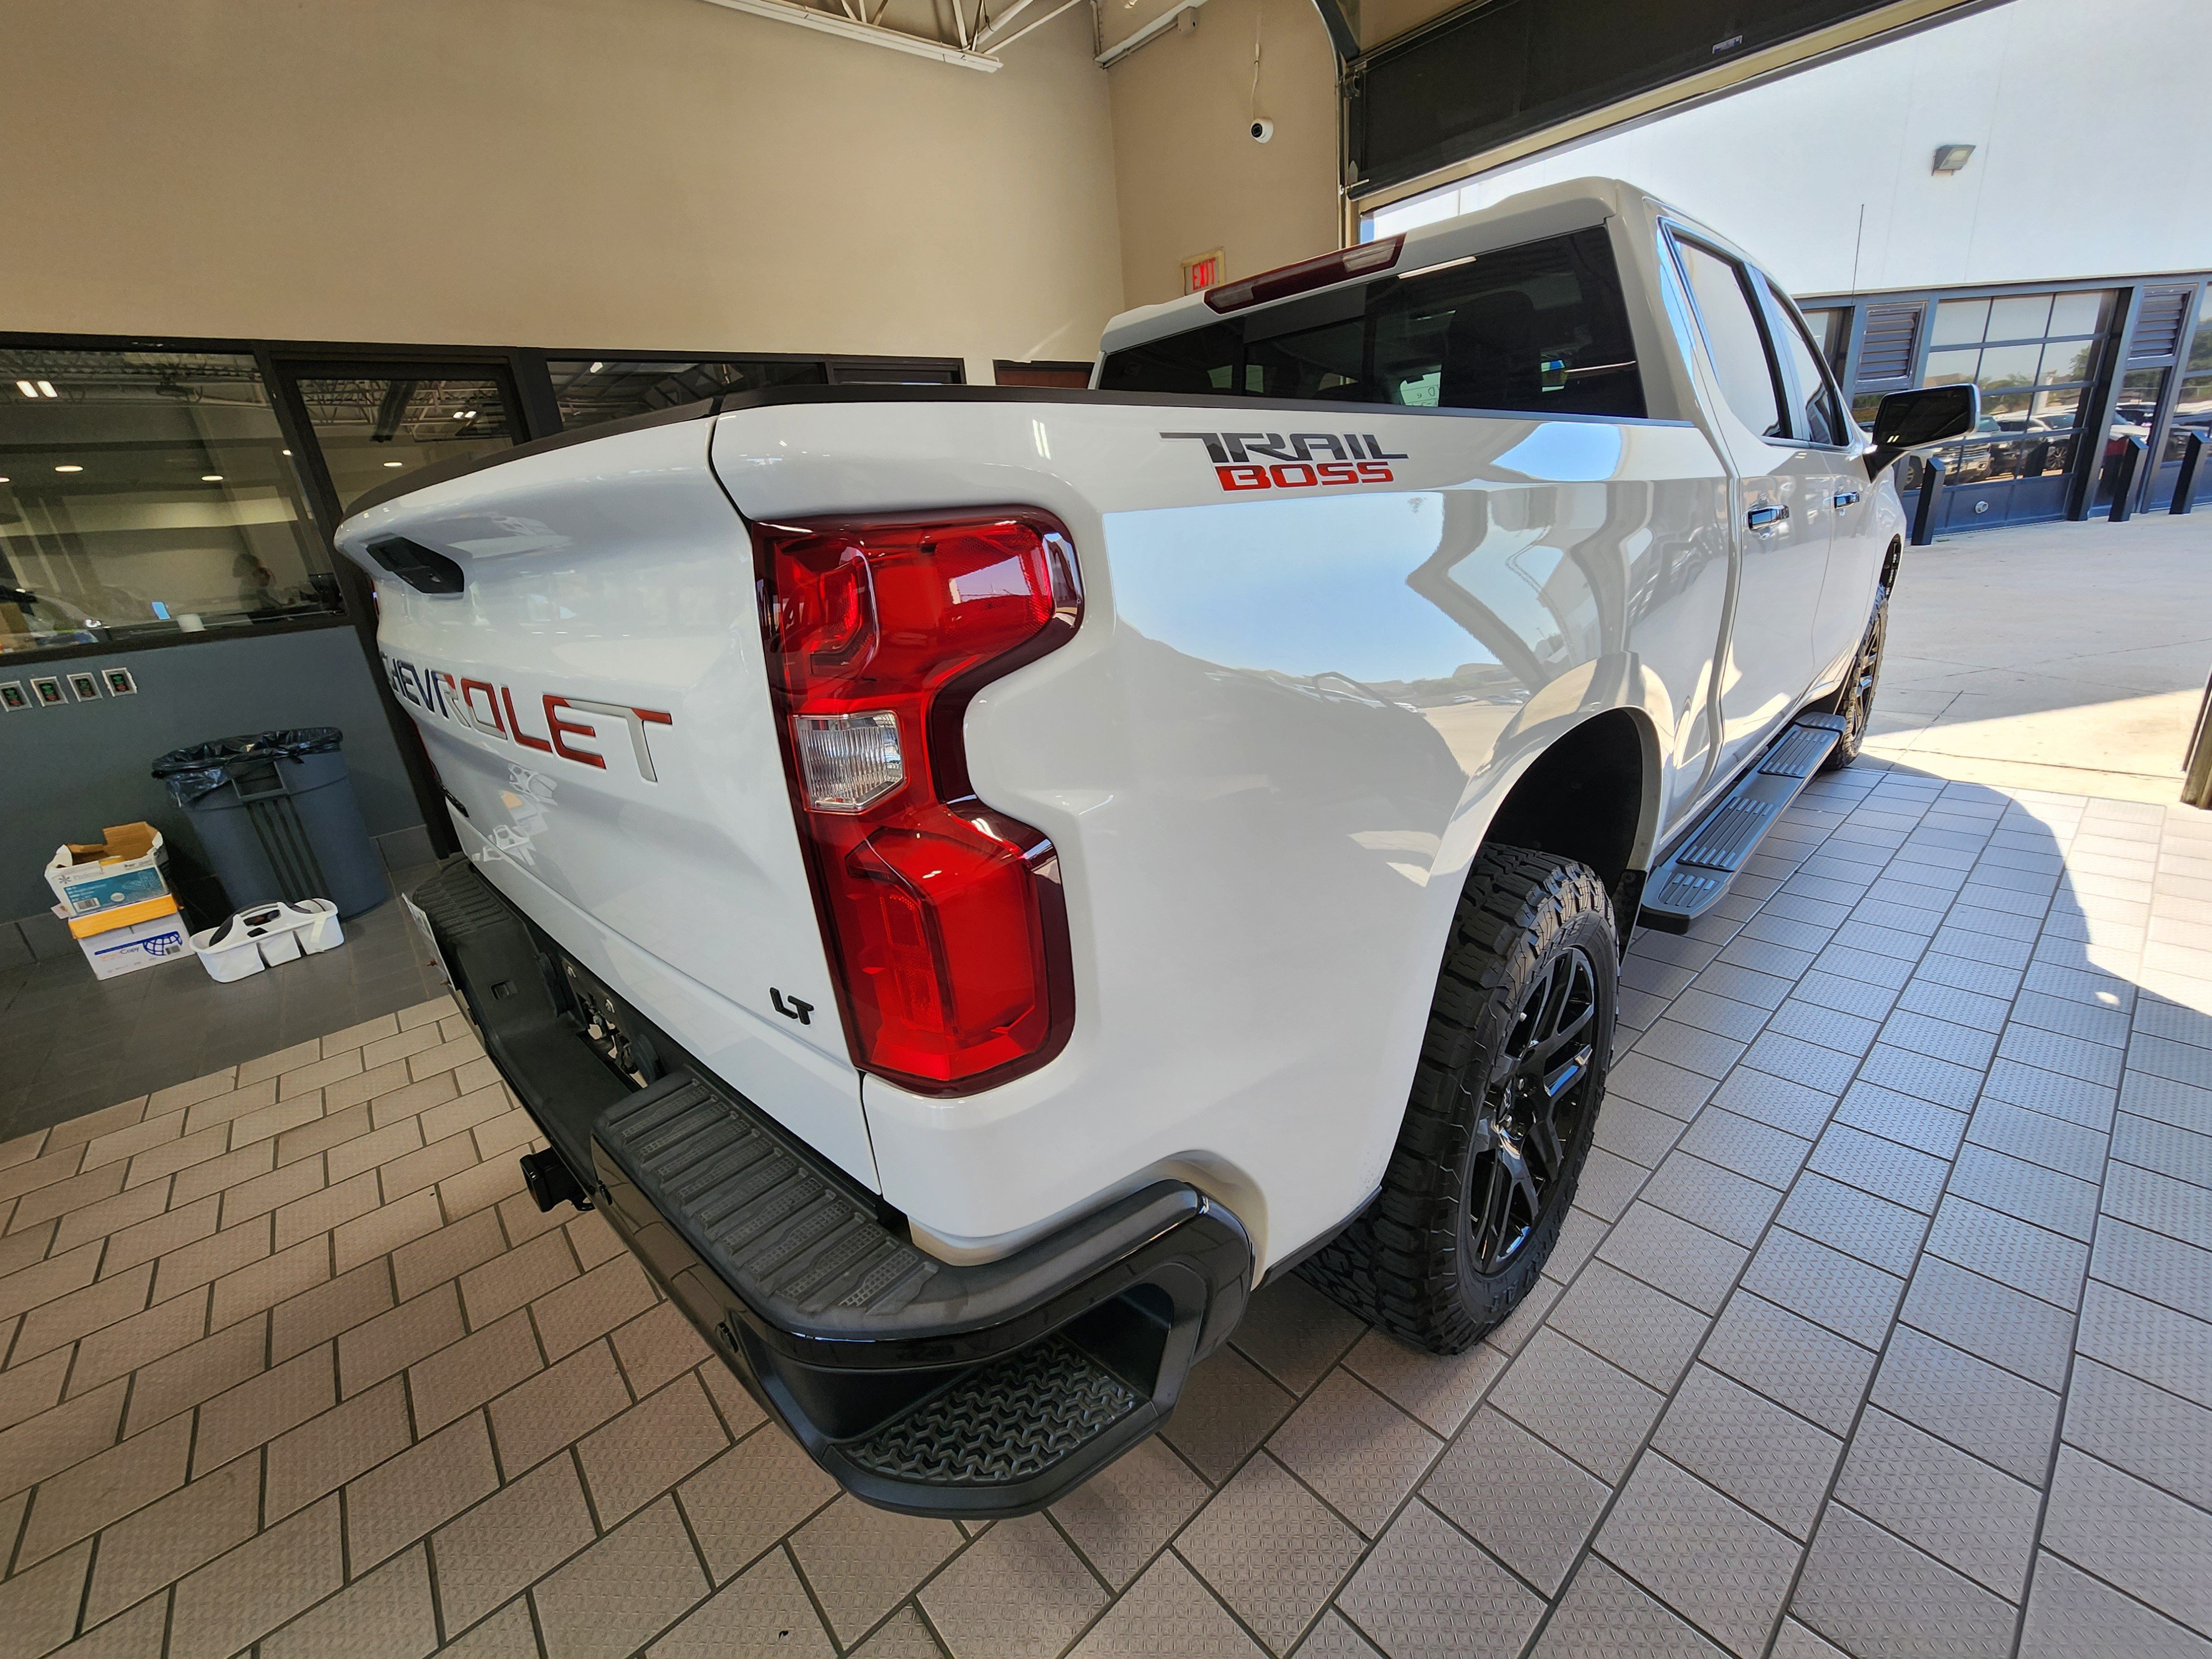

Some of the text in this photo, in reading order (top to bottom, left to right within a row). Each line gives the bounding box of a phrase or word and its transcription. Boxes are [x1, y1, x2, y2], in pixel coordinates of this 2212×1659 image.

[1192, 257, 1215, 290] EXIT
[1159, 432, 1408, 463] TRAIL
[1214, 461, 1394, 492] BOSS
[769, 987, 814, 1025] LT
